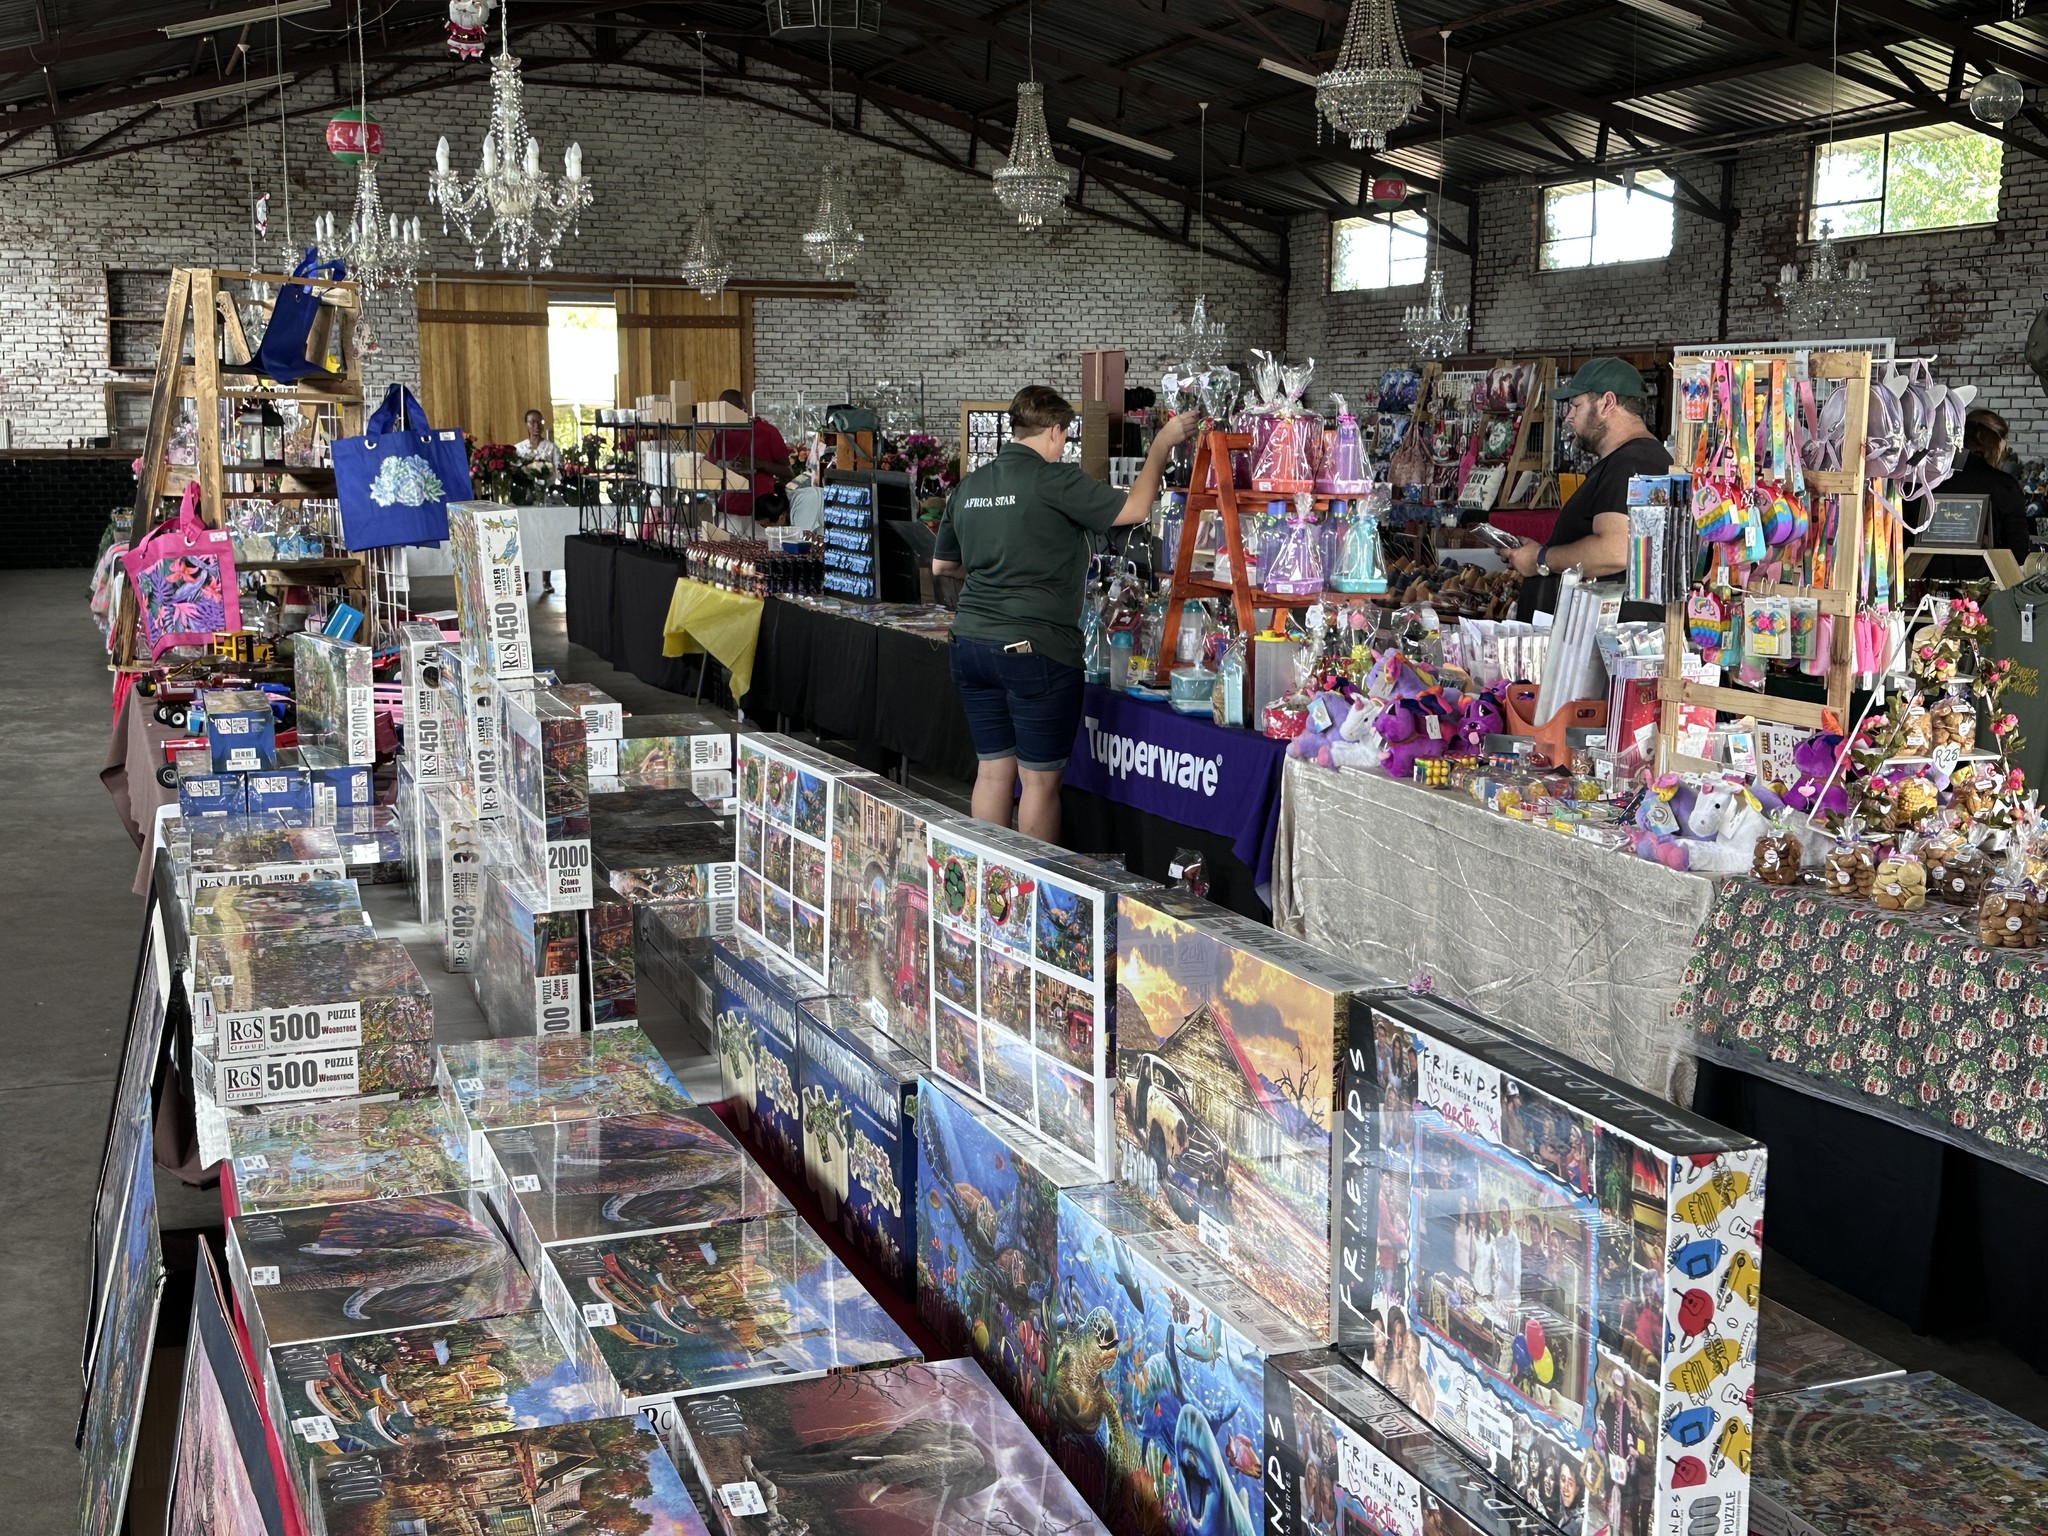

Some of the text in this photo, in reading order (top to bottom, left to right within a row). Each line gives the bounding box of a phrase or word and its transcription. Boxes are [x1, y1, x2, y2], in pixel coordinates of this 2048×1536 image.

[964, 494, 1016, 509] AFRICA STAR
[494, 602, 520, 671] RGS 450
[351, 707, 369, 737] 2000
[418, 719, 439, 752] 450
[585, 710, 599, 734] 3000
[477, 749, 498, 783] 403
[695, 740, 709, 764] 3000
[1085, 716, 1219, 798] Tupperware
[549, 844, 589, 869] 2000
[559, 868, 581, 878] PUZZLE
[714, 865, 733, 896] 1000
[543, 979, 551, 1005] PUZZLE
[230, 1009, 357, 1043] RGS 500 PUZZLE
[227, 1056, 354, 1091] RGS 500 PUZZLE
[1723, 1490, 1736, 1535] PUZZLE
